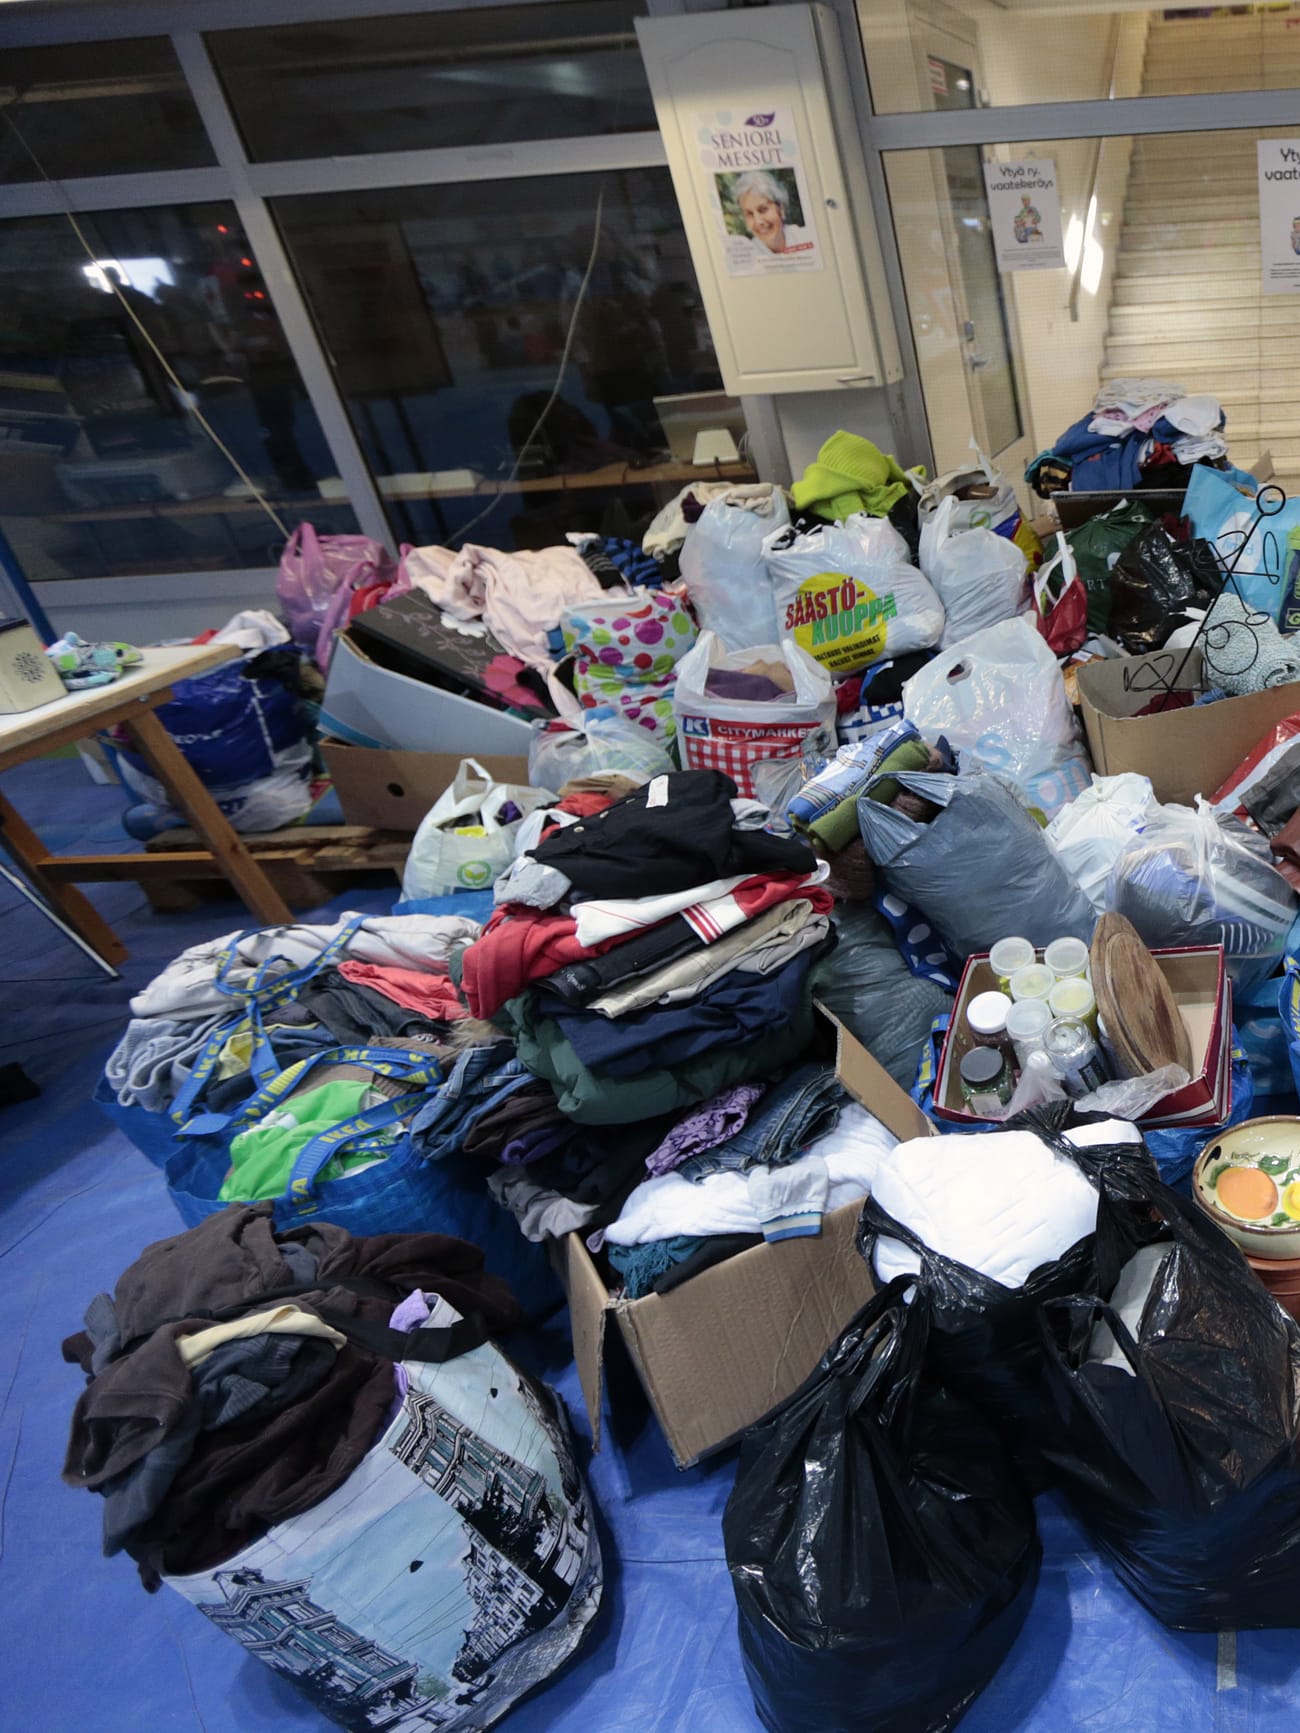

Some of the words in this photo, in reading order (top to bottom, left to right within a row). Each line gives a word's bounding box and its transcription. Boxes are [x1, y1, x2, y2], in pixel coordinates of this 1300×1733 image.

[711, 130, 782, 150] SENIORI
[718, 148, 782, 168] MESSUT
[812, 592, 898, 646] KUOPPA
[318, 1119, 375, 1143] IKEA
